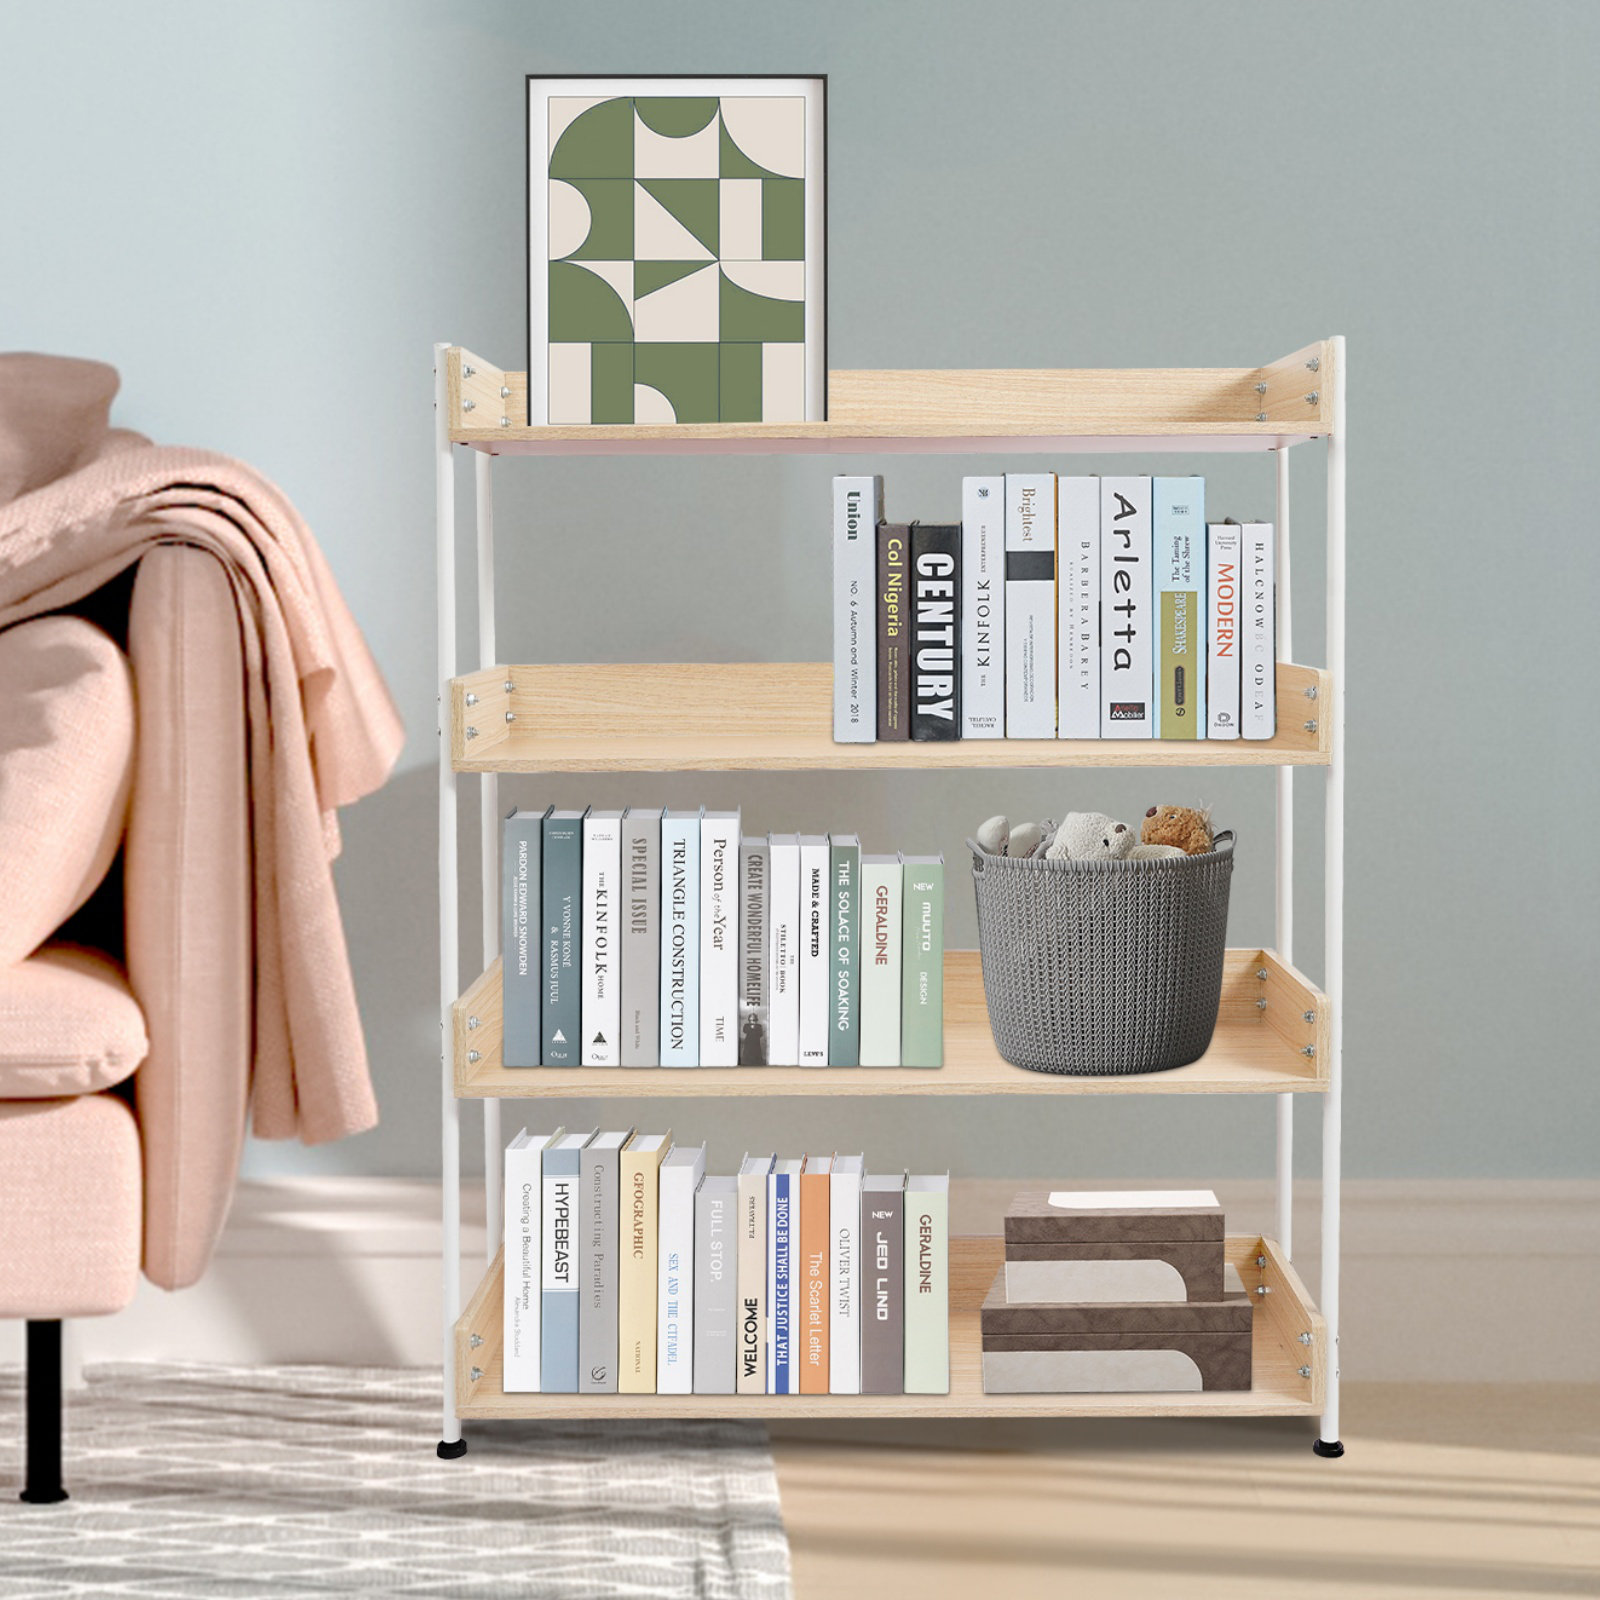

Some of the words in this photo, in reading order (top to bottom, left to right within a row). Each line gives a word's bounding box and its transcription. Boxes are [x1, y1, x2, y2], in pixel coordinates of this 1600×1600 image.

[847, 491, 861, 540] Union
[1018, 487, 1036, 542] Brightest
[887, 539, 903, 567] Col
[1172, 536, 1180, 563] Taming
[850, 580, 859, 597] NO.
[1113, 492, 1139, 672] Arletta
[1172, 570, 1180, 582] The
[884, 573, 903, 637] Nigeria
[977, 580, 991, 667] KINFOLK
[1172, 592, 1187, 655] SHAKESPEARE
[1217, 563, 1235, 657] MODERN
[850, 610, 859, 646] Autumn
[916, 552, 955, 721] CENTURY
[850, 647, 859, 665] and
[850, 668, 859, 699] Winter
[850, 703, 860, 723] 2018
[518, 840, 527, 880] PARDON
[632, 838, 647, 892] SPECIAL
[672, 839, 686, 920] TRIANGLE
[713, 839, 727, 892] Person
[747, 855, 763, 889] CREATE
[839, 861, 849, 886] THE
[811, 868, 819, 898] MADE
[913, 883, 934, 891] NEW
[519, 883, 527, 924] EDWARD
[562, 904, 571, 939] VONNE
[631, 898, 647, 934] ISSUE
[811, 900, 819, 908] &
[838, 892, 849, 942] SOLACE
[550, 926, 558, 934] &
[596, 889, 608, 975] KINFOLK
[713, 917, 726, 950] Year
[747, 895, 763, 954] WONDERFUL
[811, 910, 819, 957] CRAFTED
[875, 886, 888, 965] GERALDINE
[519, 926, 527, 975] SNOWDEN
[550, 940, 559, 979] RASMUS
[838, 947, 849, 965] OF
[549, 979, 559, 1004] JUUL
[671, 924, 685, 1050] CONSTRUCTION
[746, 958, 761, 1007] HOMELIFE
[837, 971, 849, 1031] SOAKING
[919, 971, 928, 1005] DESIGN
[715, 1016, 724, 1043] TIME
[521, 1183, 531, 1224] Creating
[592, 1165, 605, 1247] Constructing
[710, 1200, 724, 1237] FULL
[776, 1197, 788, 1227] DONE
[872, 1211, 893, 1219] NEW
[554, 1183, 569, 1283] HYPEBEAST
[776, 1229, 788, 1244] BE
[839, 1228, 850, 1275] OLIVER
[876, 1232, 888, 1269] JED
[522, 1235, 531, 1278] Beautiful
[668, 1253, 678, 1272] SEX
[710, 1241, 723, 1284] STOP.
[776, 1246, 788, 1280] SHALL
[809, 1252, 822, 1277] The
[919, 1214, 932, 1293] GERALDINE
[522, 1281, 531, 1310] Home
[593, 1253, 604, 1309] Paradies
[668, 1276, 678, 1296] AND
[839, 1277, 850, 1318] TWIST
[876, 1278, 888, 1321] LIND
[667, 1300, 678, 1319] THE
[776, 1284, 788, 1330] JUSTICE
[808, 1280, 823, 1325] Scarlet
[744, 1298, 758, 1377] WELCOME
[776, 1335, 788, 1366] THAT
[808, 1329, 822, 1366] Letter
